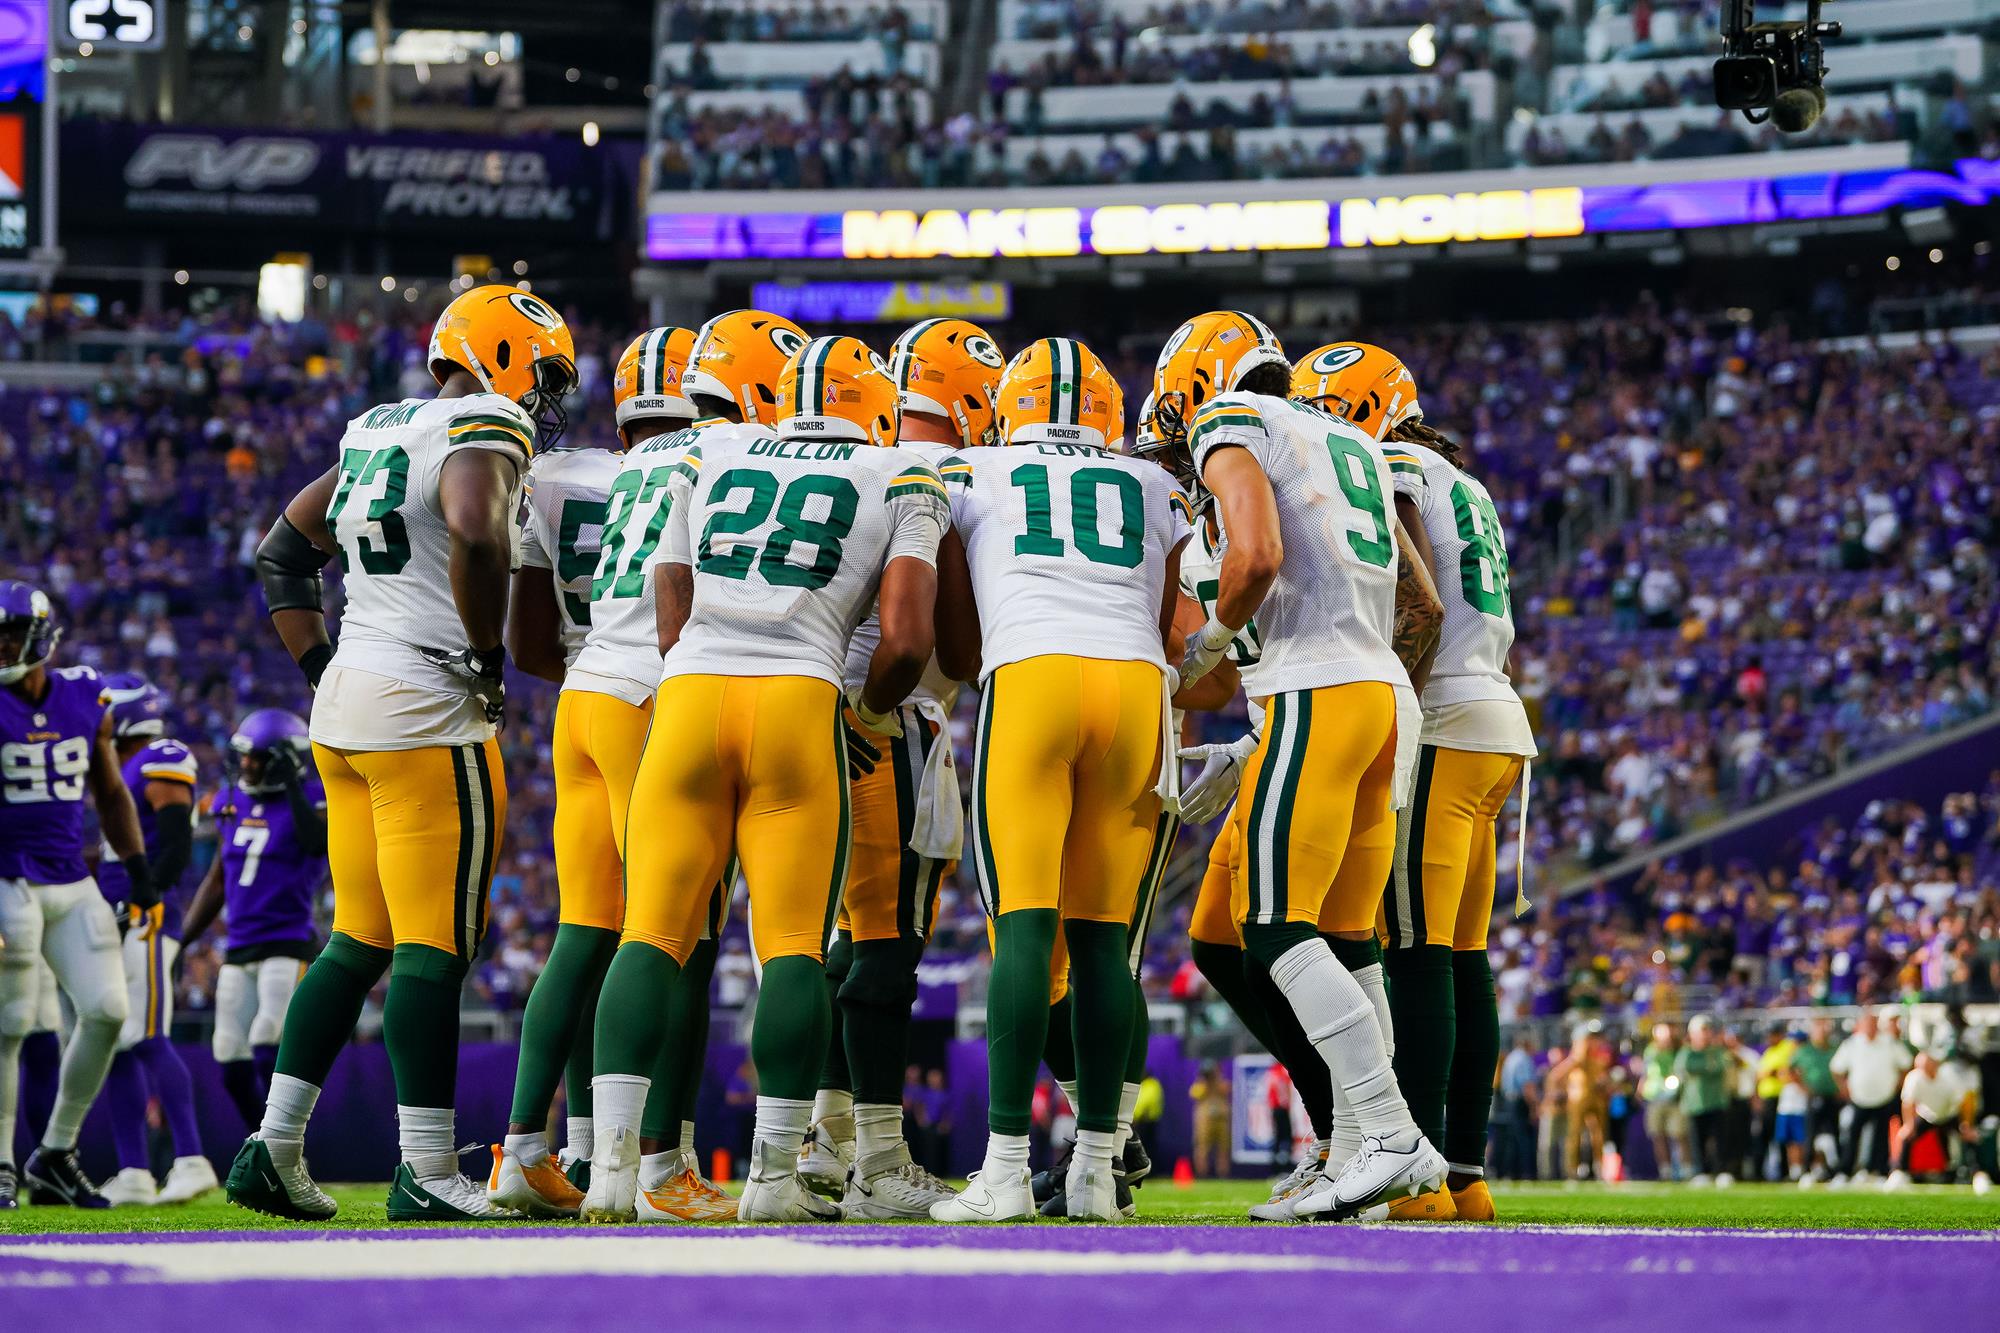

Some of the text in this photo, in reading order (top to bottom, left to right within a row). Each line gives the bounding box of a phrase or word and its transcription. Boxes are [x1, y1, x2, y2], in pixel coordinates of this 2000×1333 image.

[125, 135, 320, 190] FVP
[842, 186, 1584, 259] MAKE SOME NOISE
[1311, 346, 1365, 375] G
[634, 399, 665, 410] PACKERS
[793, 421, 825, 432] PACKERS
[747, 437, 860, 461] DILLON
[1036, 444, 1116, 460] LOVE
[1047, 428, 1081, 440] PACKERS
[326, 445, 412, 575] 73
[695, 469, 860, 590] 28
[1010, 463, 1144, 569] 10
[1326, 432, 1393, 569] 9
[1, 736, 89, 804] 99
[233, 826, 270, 887] 7
